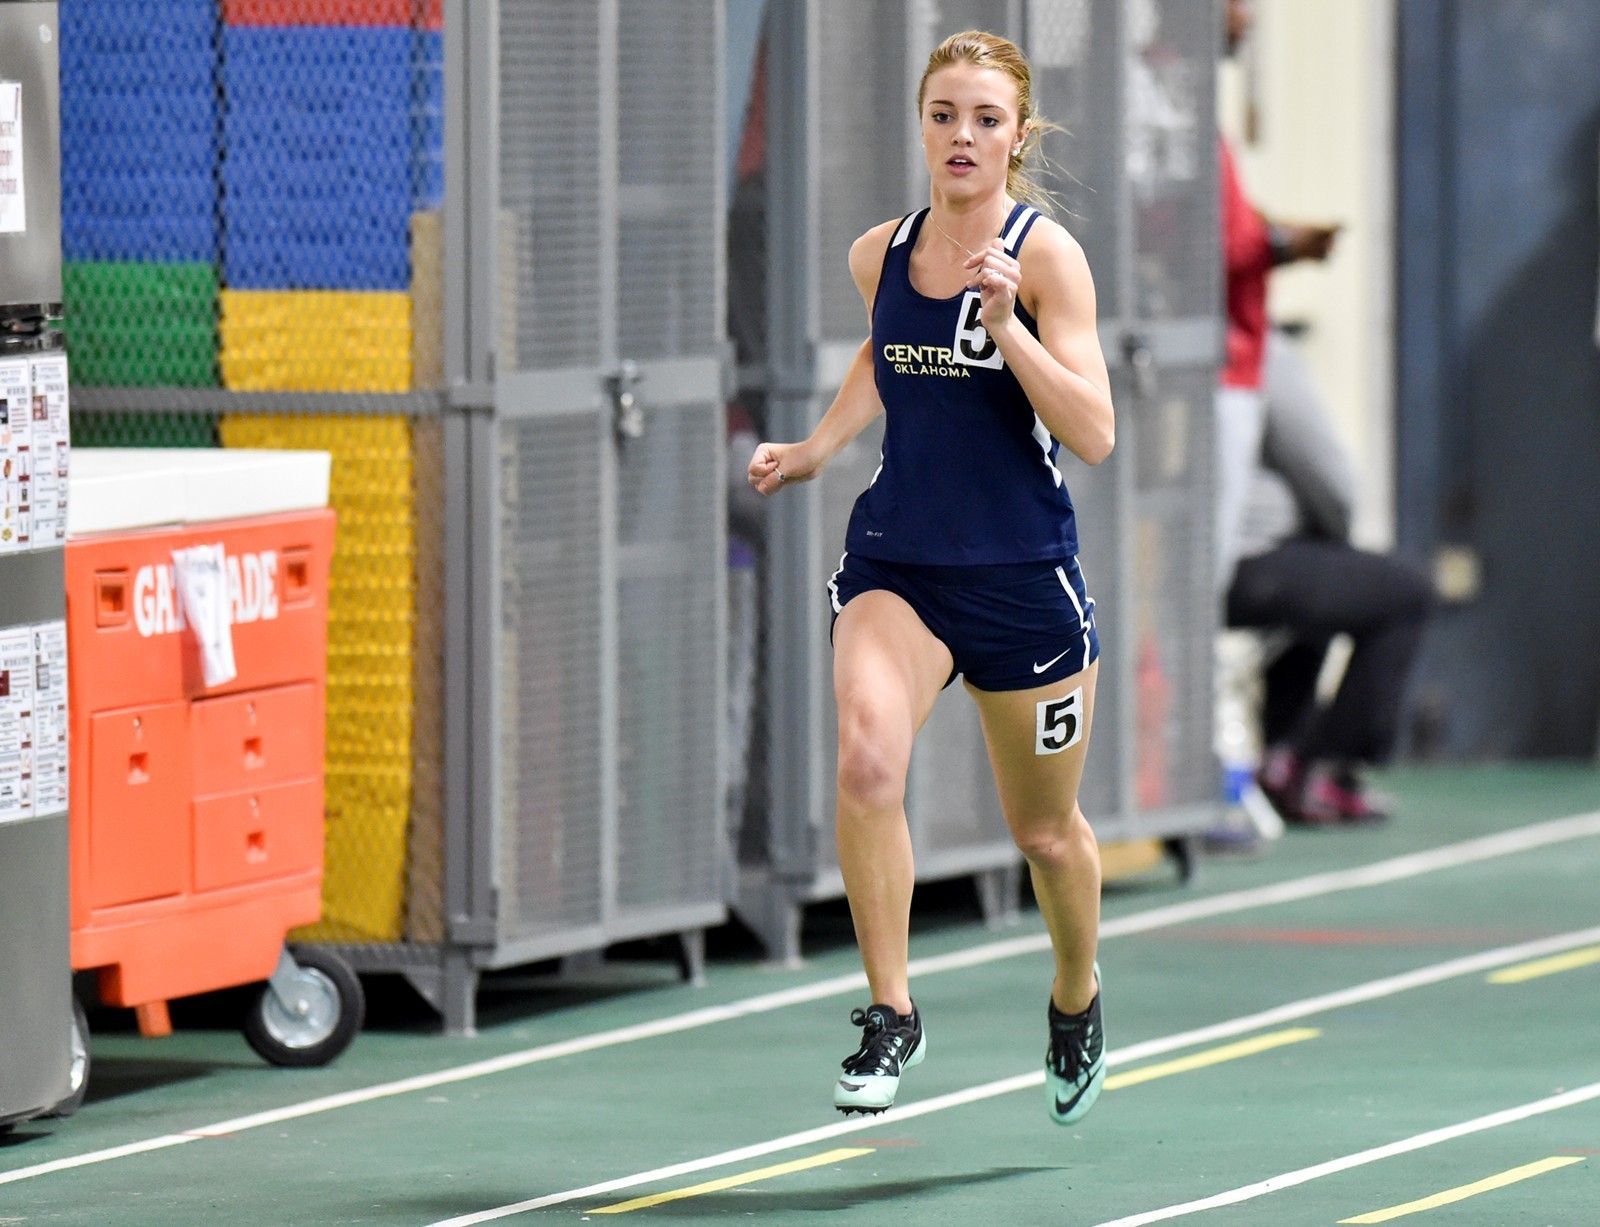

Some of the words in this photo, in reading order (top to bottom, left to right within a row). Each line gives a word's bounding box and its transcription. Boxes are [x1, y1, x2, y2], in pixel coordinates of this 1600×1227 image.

[883, 344, 969, 367] CENTR
[960, 297, 998, 361] 5
[894, 364, 971, 378] OKLAHOMA
[133, 550, 279, 638] GAADE
[1042, 695, 1077, 750] 5
